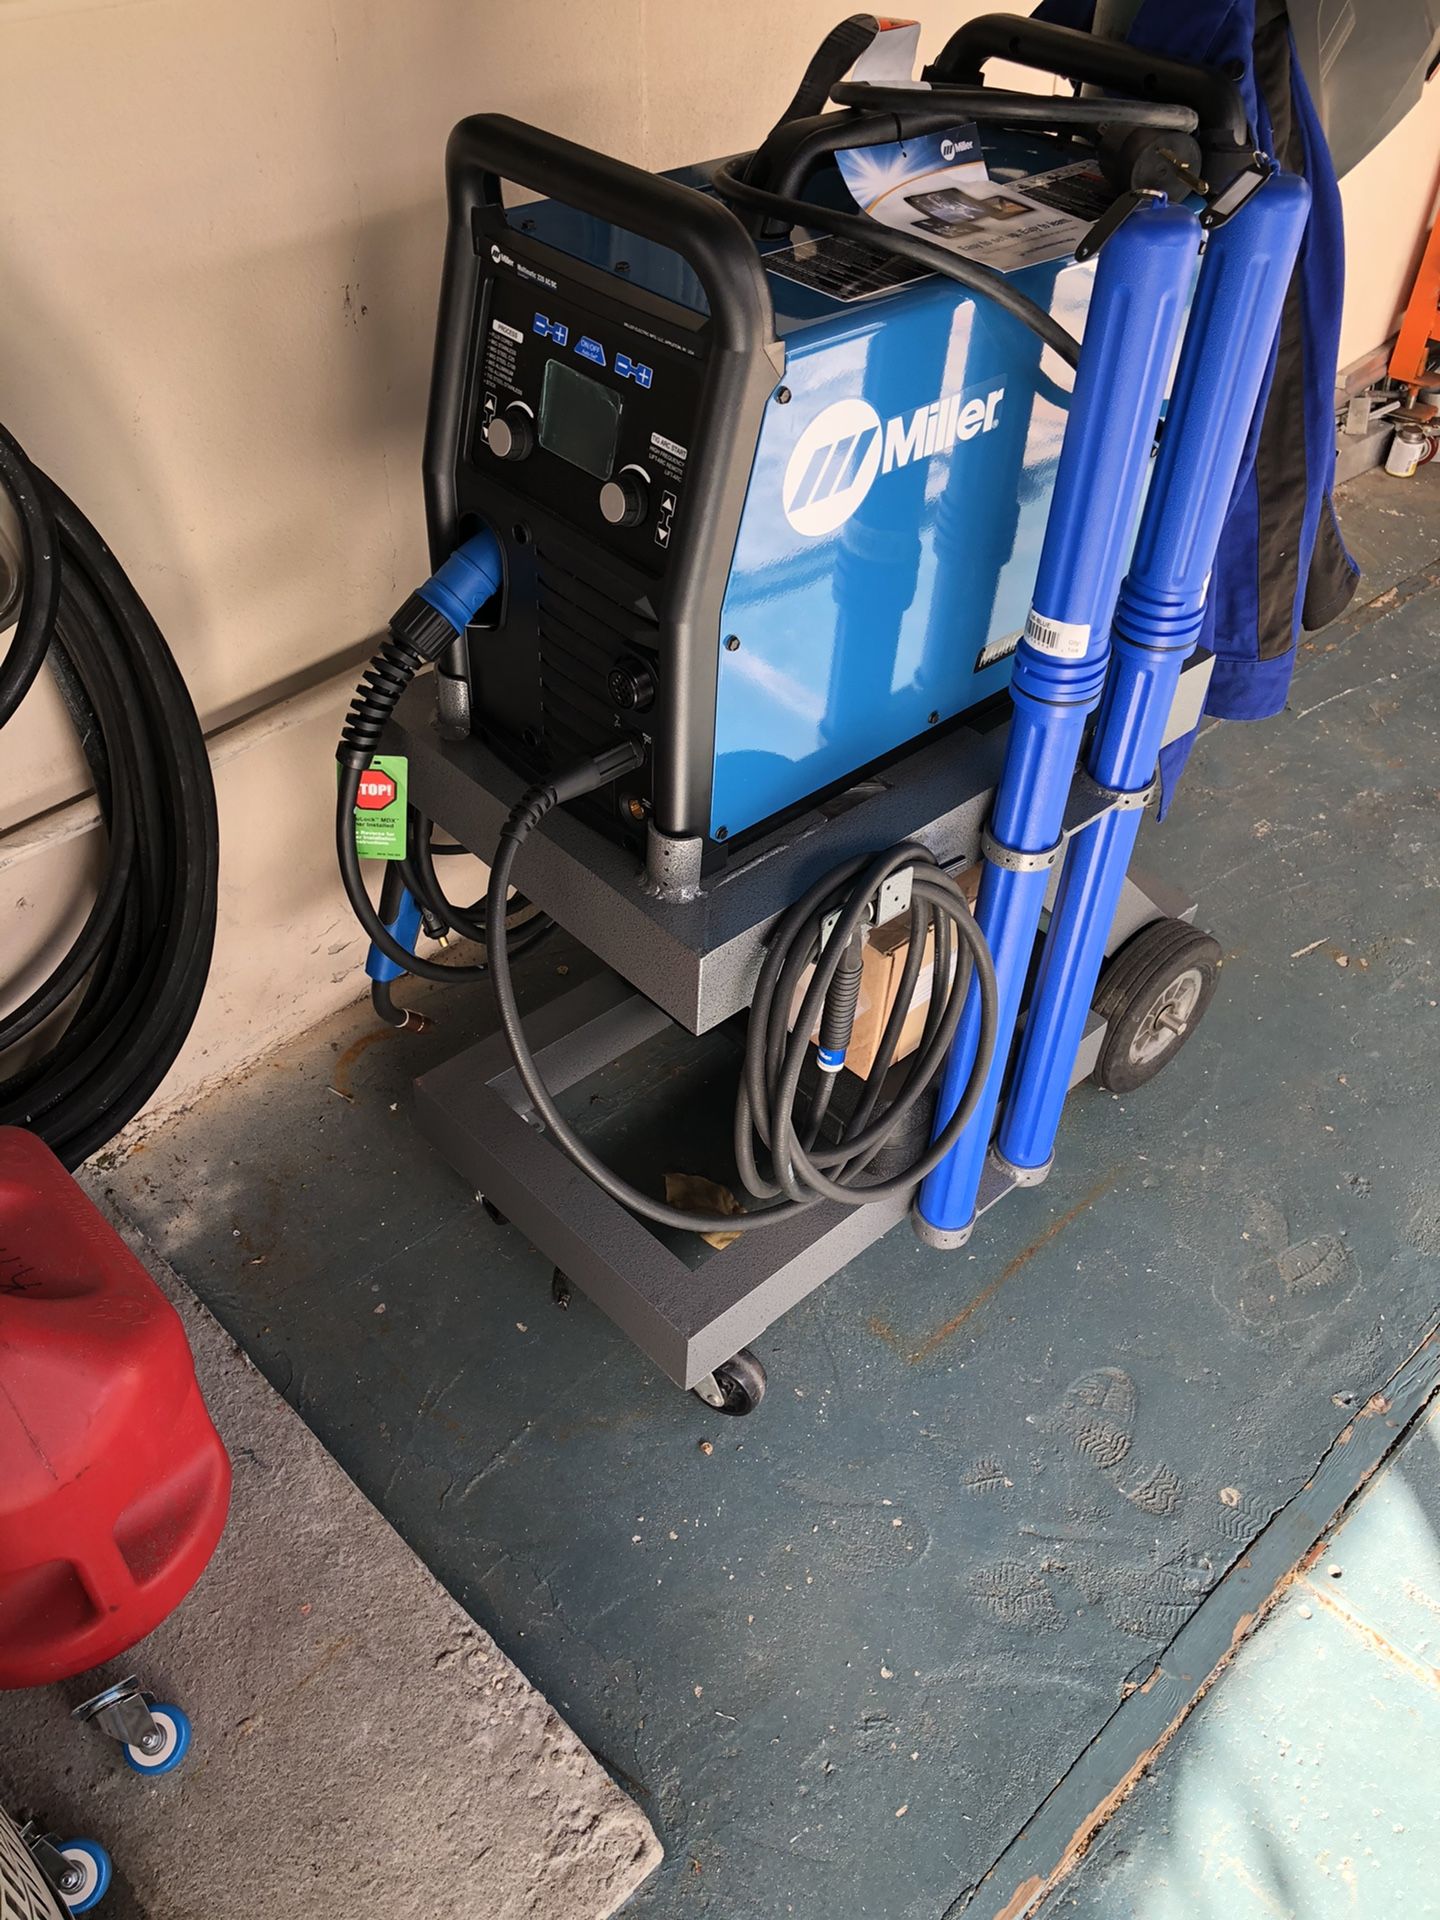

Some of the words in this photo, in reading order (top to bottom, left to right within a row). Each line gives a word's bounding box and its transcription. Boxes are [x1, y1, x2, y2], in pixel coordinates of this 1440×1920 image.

[954, 140, 974, 153] Miller
[497, 323, 519, 339] PROCESS
[881, 387, 1005, 475] Miller
[660, 439, 671, 451] ARC
[671, 444, 687, 458] START
[358, 783, 392, 797] TOP!
